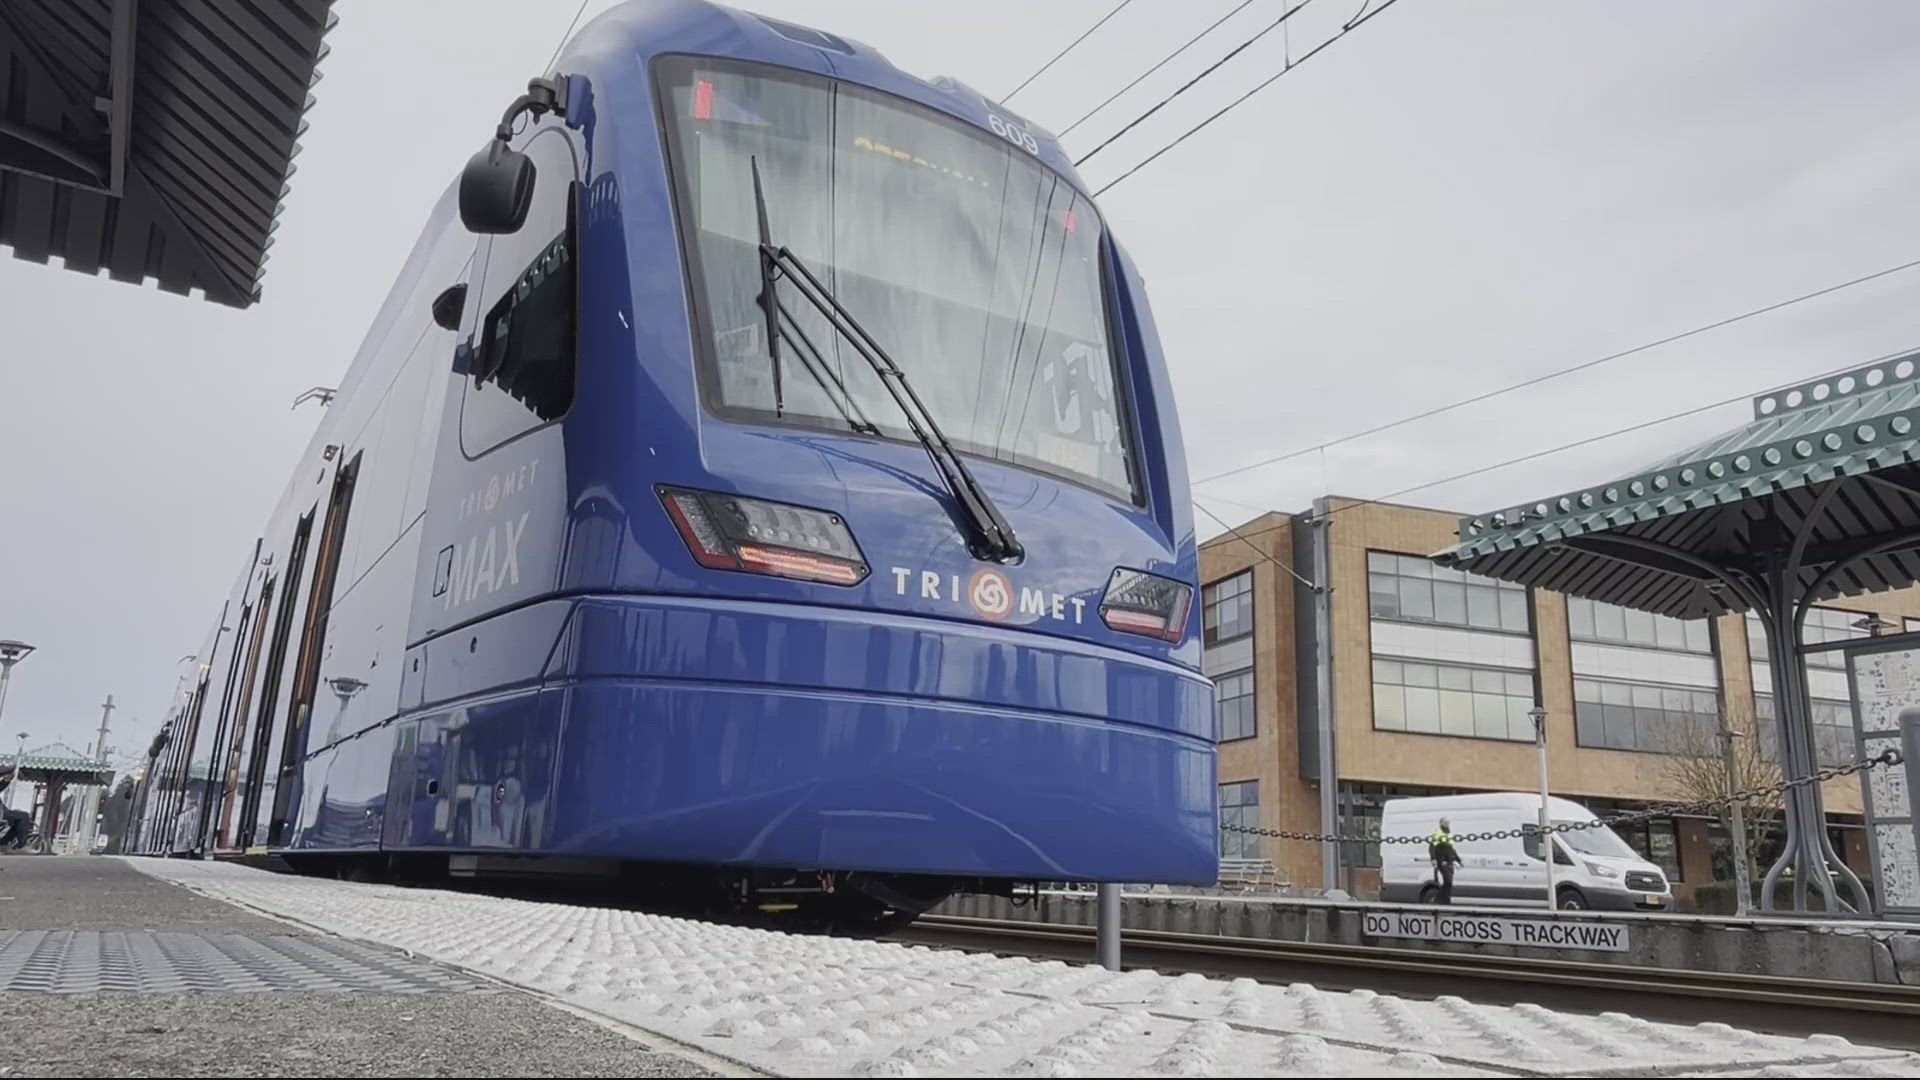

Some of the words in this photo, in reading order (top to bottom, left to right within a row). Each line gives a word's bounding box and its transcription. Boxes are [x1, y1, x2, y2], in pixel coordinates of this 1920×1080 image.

[988, 114, 1039, 155] 609
[503, 459, 539, 497] MET
[444, 510, 530, 611] MAX
[891, 567, 960, 602] TRI
[1019, 587, 1086, 624] MET
[1367, 916, 1390, 933] DO
[1399, 917, 1431, 936] NOT
[1440, 919, 1502, 940] CROSS
[1511, 923, 1621, 947] TRACKWAY
